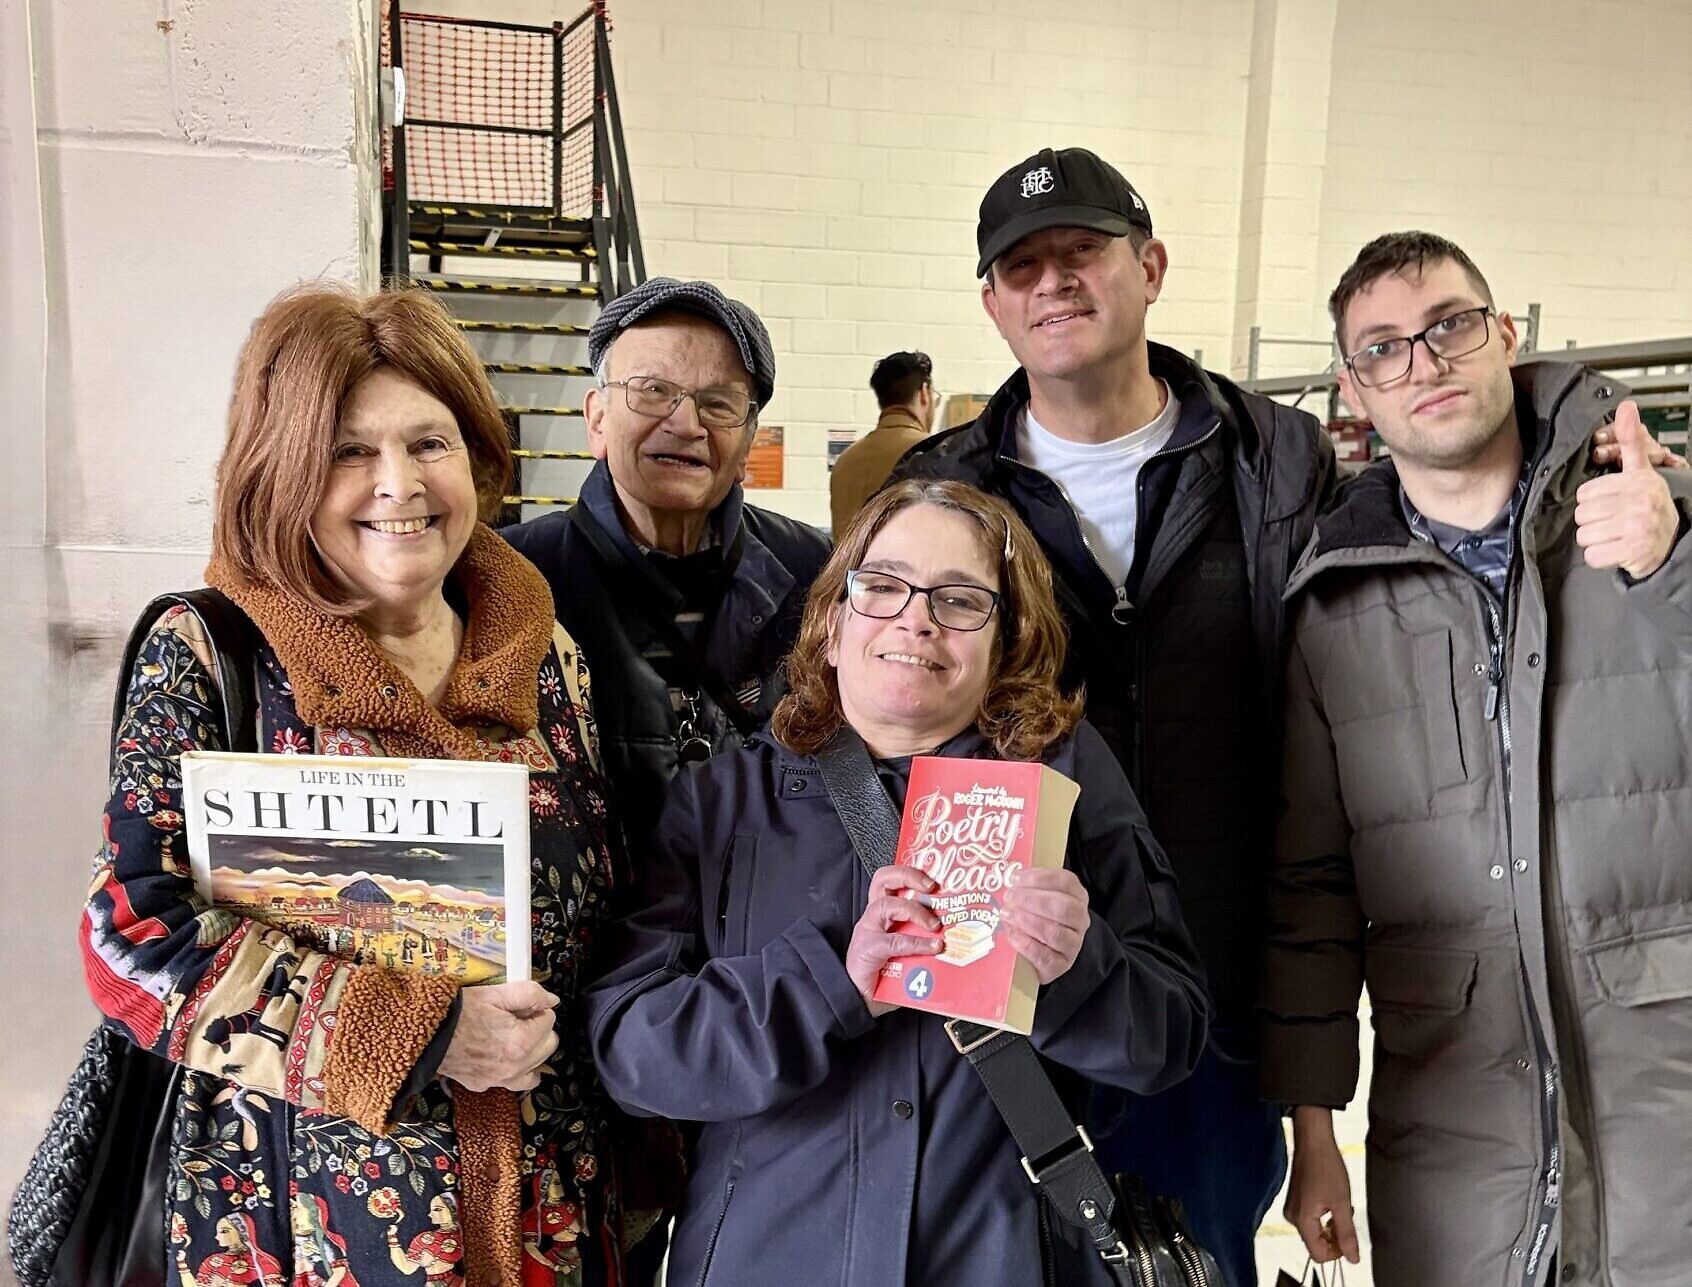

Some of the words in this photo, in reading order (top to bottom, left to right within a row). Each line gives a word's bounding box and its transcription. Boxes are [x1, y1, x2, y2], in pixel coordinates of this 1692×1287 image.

[299, 770, 340, 786] LIFE
[345, 772, 364, 786] IN
[367, 773, 406, 788] THE
[203, 788, 503, 838] SHTETL
[906, 786, 1025, 863] Poetry
[930, 896, 949, 910] THE
[908, 970, 928, 998] 4
